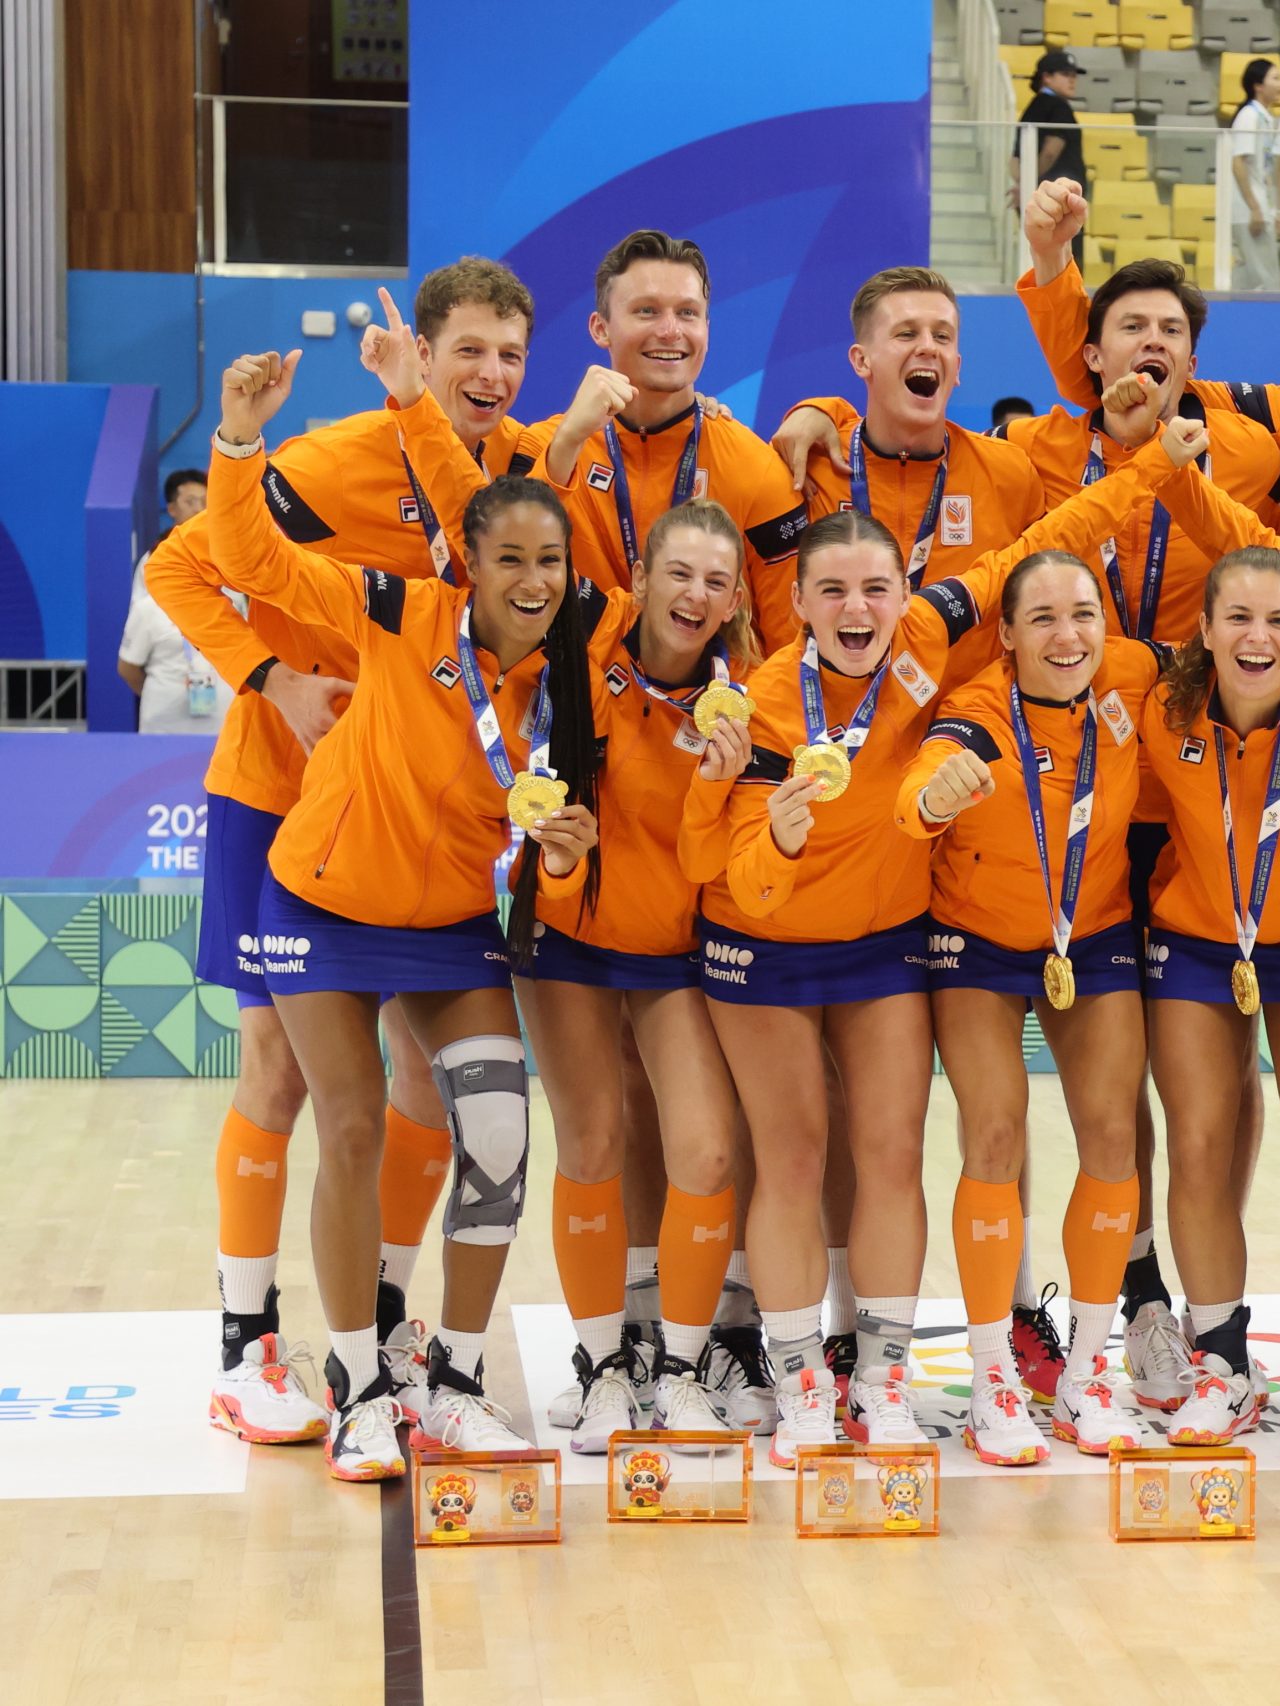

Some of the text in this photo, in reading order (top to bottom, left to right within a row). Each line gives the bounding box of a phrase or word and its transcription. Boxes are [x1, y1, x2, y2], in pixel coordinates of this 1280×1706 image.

[147, 846, 199, 870] THE
[264, 958, 306, 973] TeamNL
[704, 962, 747, 984] TeamNL
